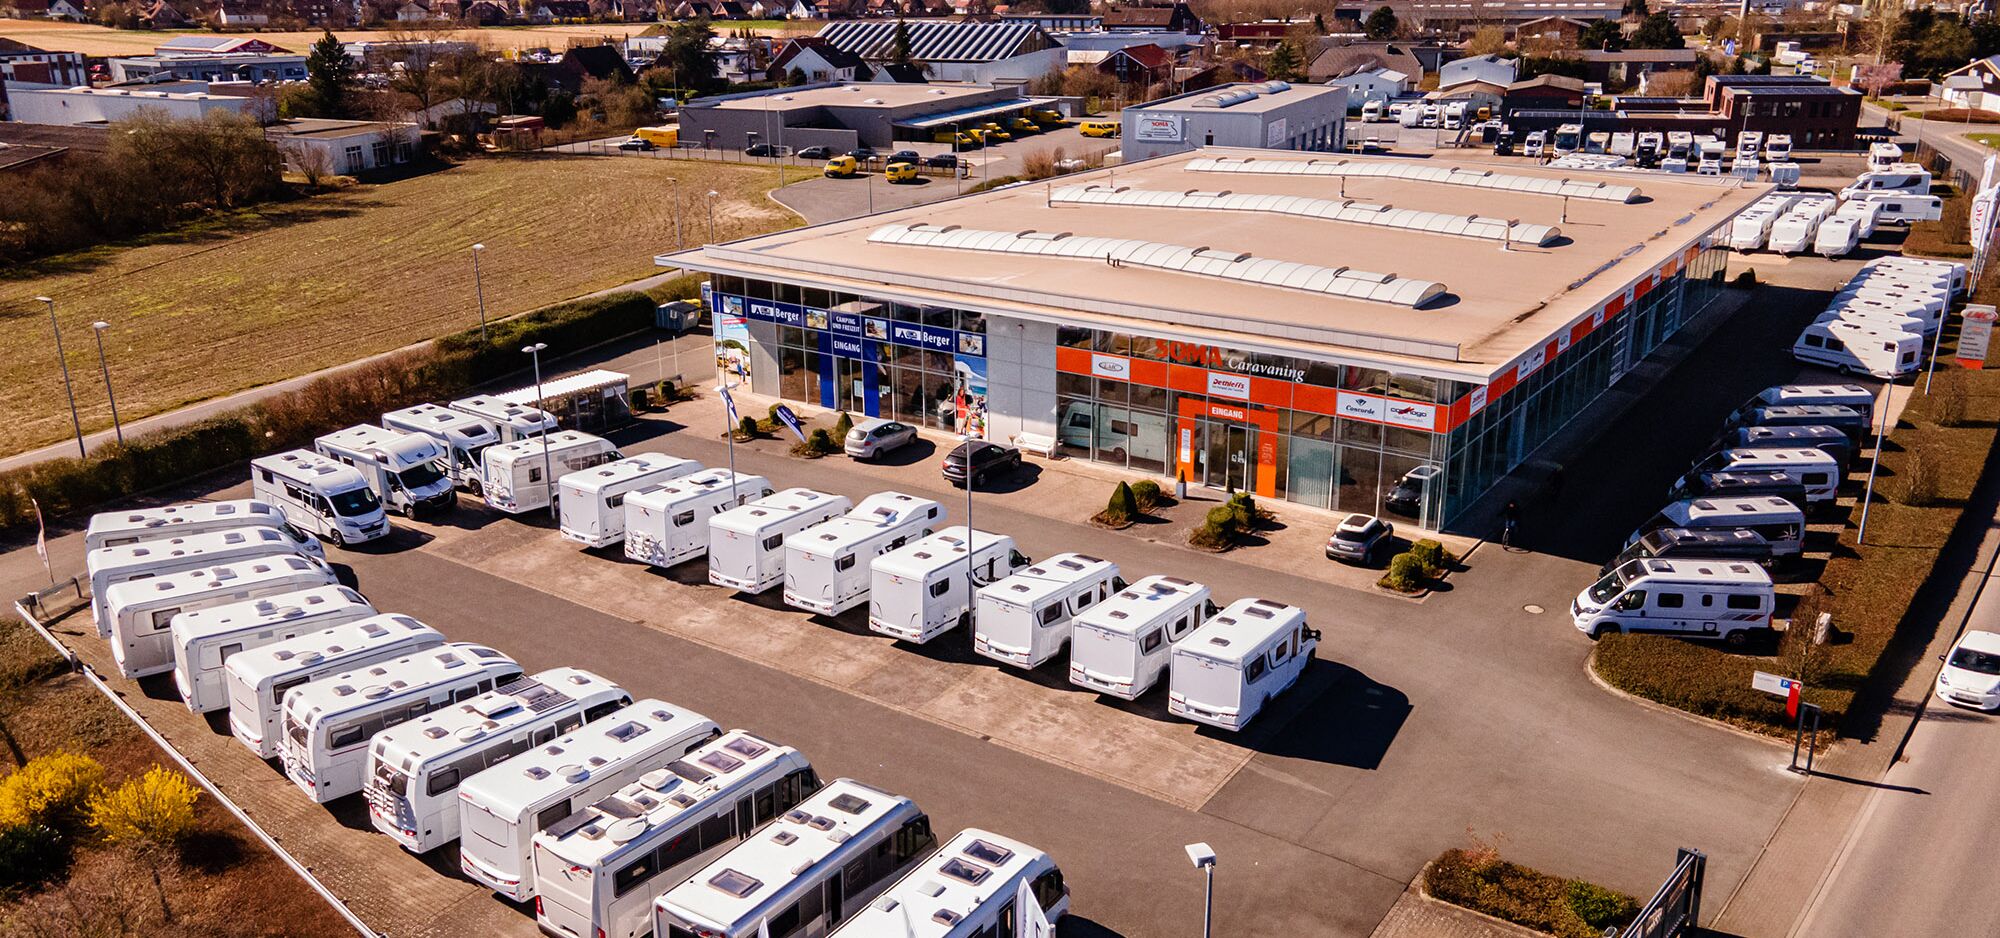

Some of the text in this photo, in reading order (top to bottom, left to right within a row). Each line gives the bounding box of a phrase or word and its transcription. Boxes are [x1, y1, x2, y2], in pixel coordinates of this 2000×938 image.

[775, 307, 800, 322] Berger
[835, 315, 856, 325] CAMPING
[832, 322, 842, 330] UND
[922, 331, 951, 347] Berger
[833, 340, 860, 353] EINGANG
[1154, 338, 1306, 382] SOMA Caravaning
[1211, 406, 1244, 419] EINGANG
[1345, 404, 1375, 415] Concorde
